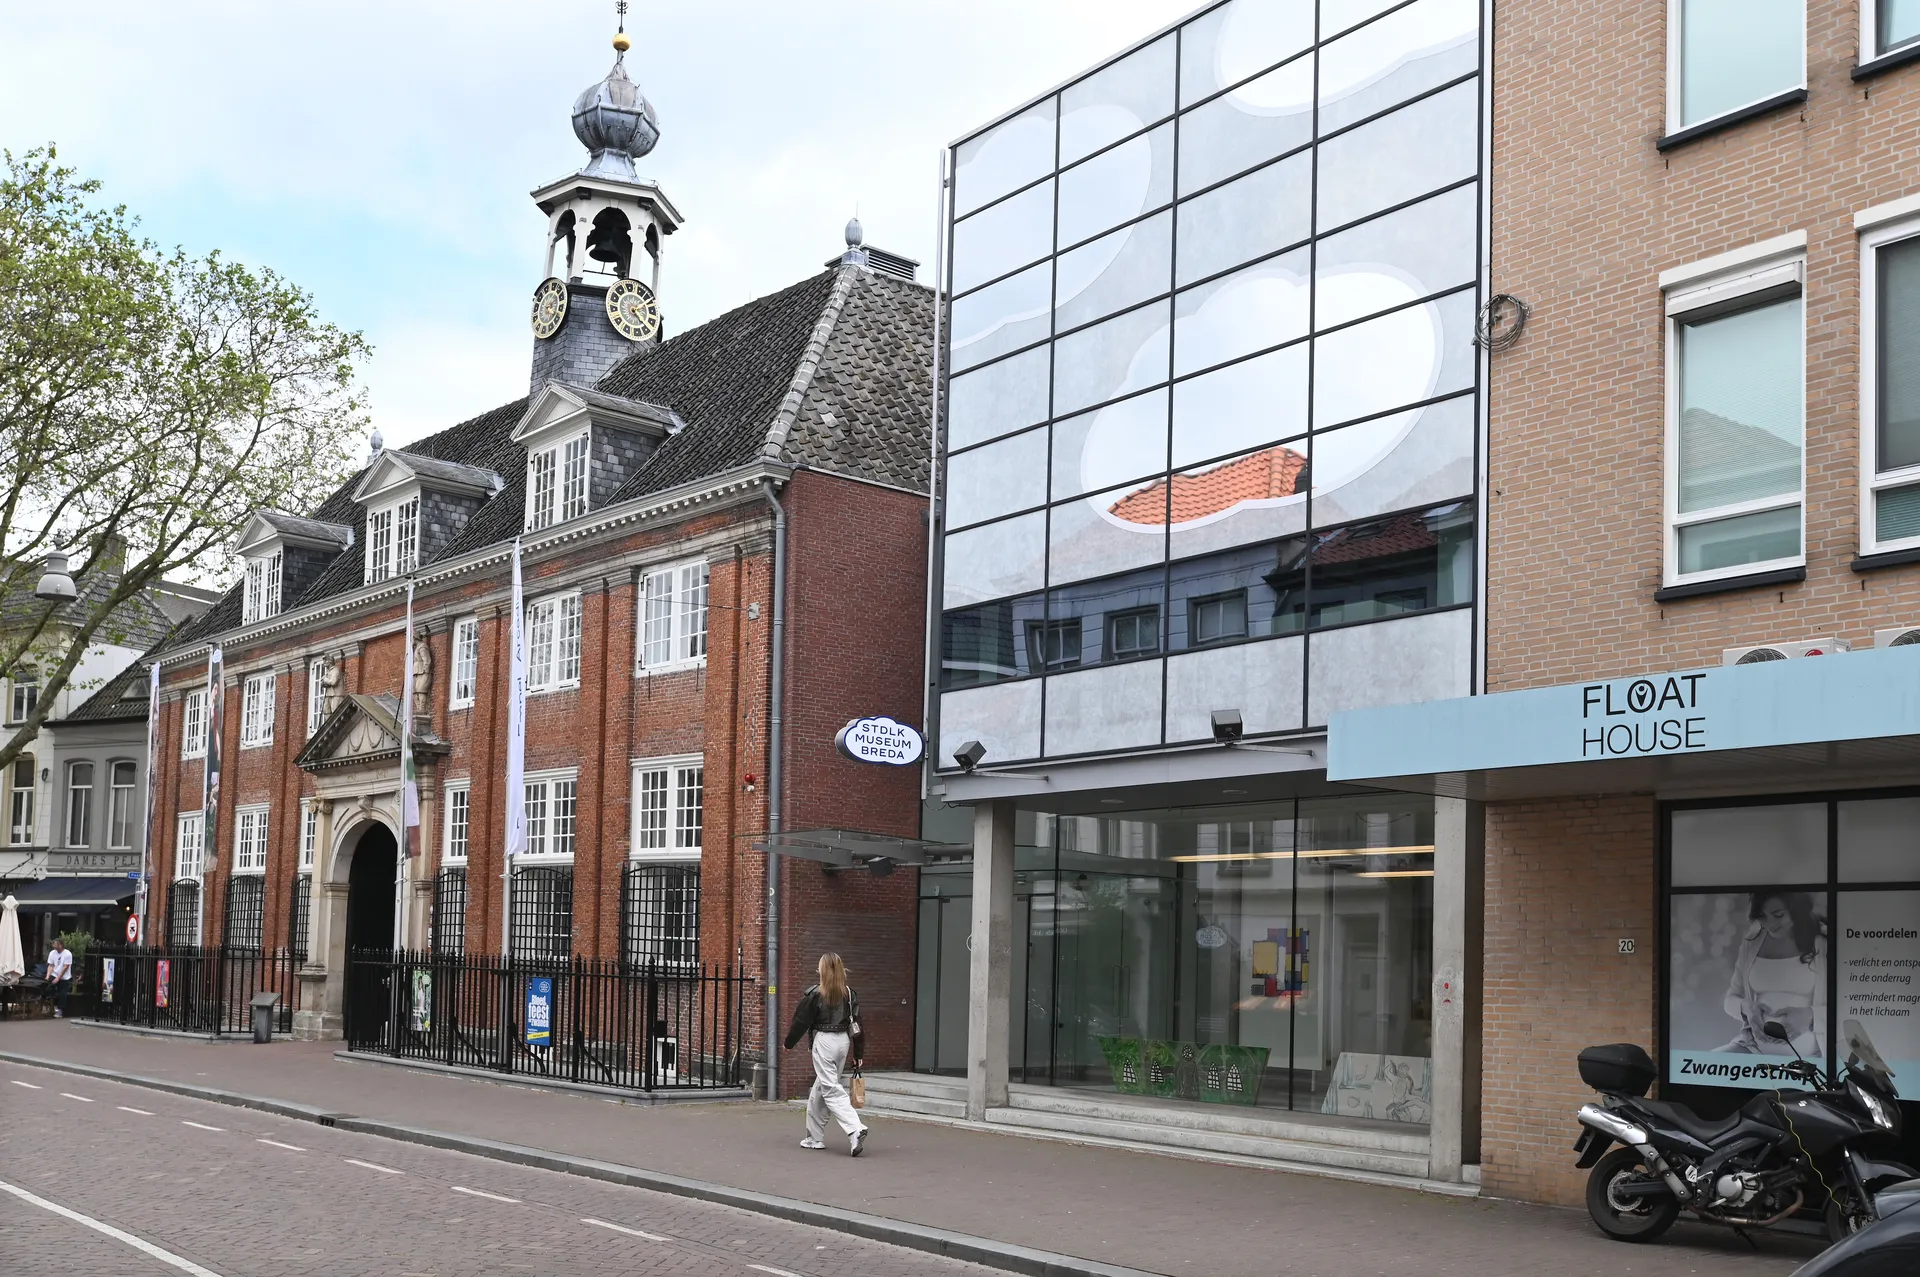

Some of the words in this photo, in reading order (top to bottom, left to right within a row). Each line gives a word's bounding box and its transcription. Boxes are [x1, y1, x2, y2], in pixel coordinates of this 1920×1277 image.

[1583, 673, 1707, 718] FLOAT
[862, 723, 905, 737] STDLK
[1582, 716, 1706, 757] HOUSE
[855, 733, 912, 750] MUSEUM
[861, 746, 905, 760] BREDA
[66, 855, 106, 866] DAMES
[1846, 928, 1861, 939] De
[1862, 927, 1918, 939] voordelen
[1620, 940, 1634, 952] 20
[1849, 957, 1880, 967] verlicht
[1881, 959, 1892, 967] en
[1849, 972, 1858, 982] in
[1859, 972, 1870, 983] de
[1871, 972, 1912, 986] onderrug
[1849, 991, 1896, 1002] vermindert
[529, 1002, 549, 1020] feest
[1849, 1006, 1858, 1016] in
[1859, 1005, 1874, 1016] het
[1874, 1006, 1910, 1017] lichaam
